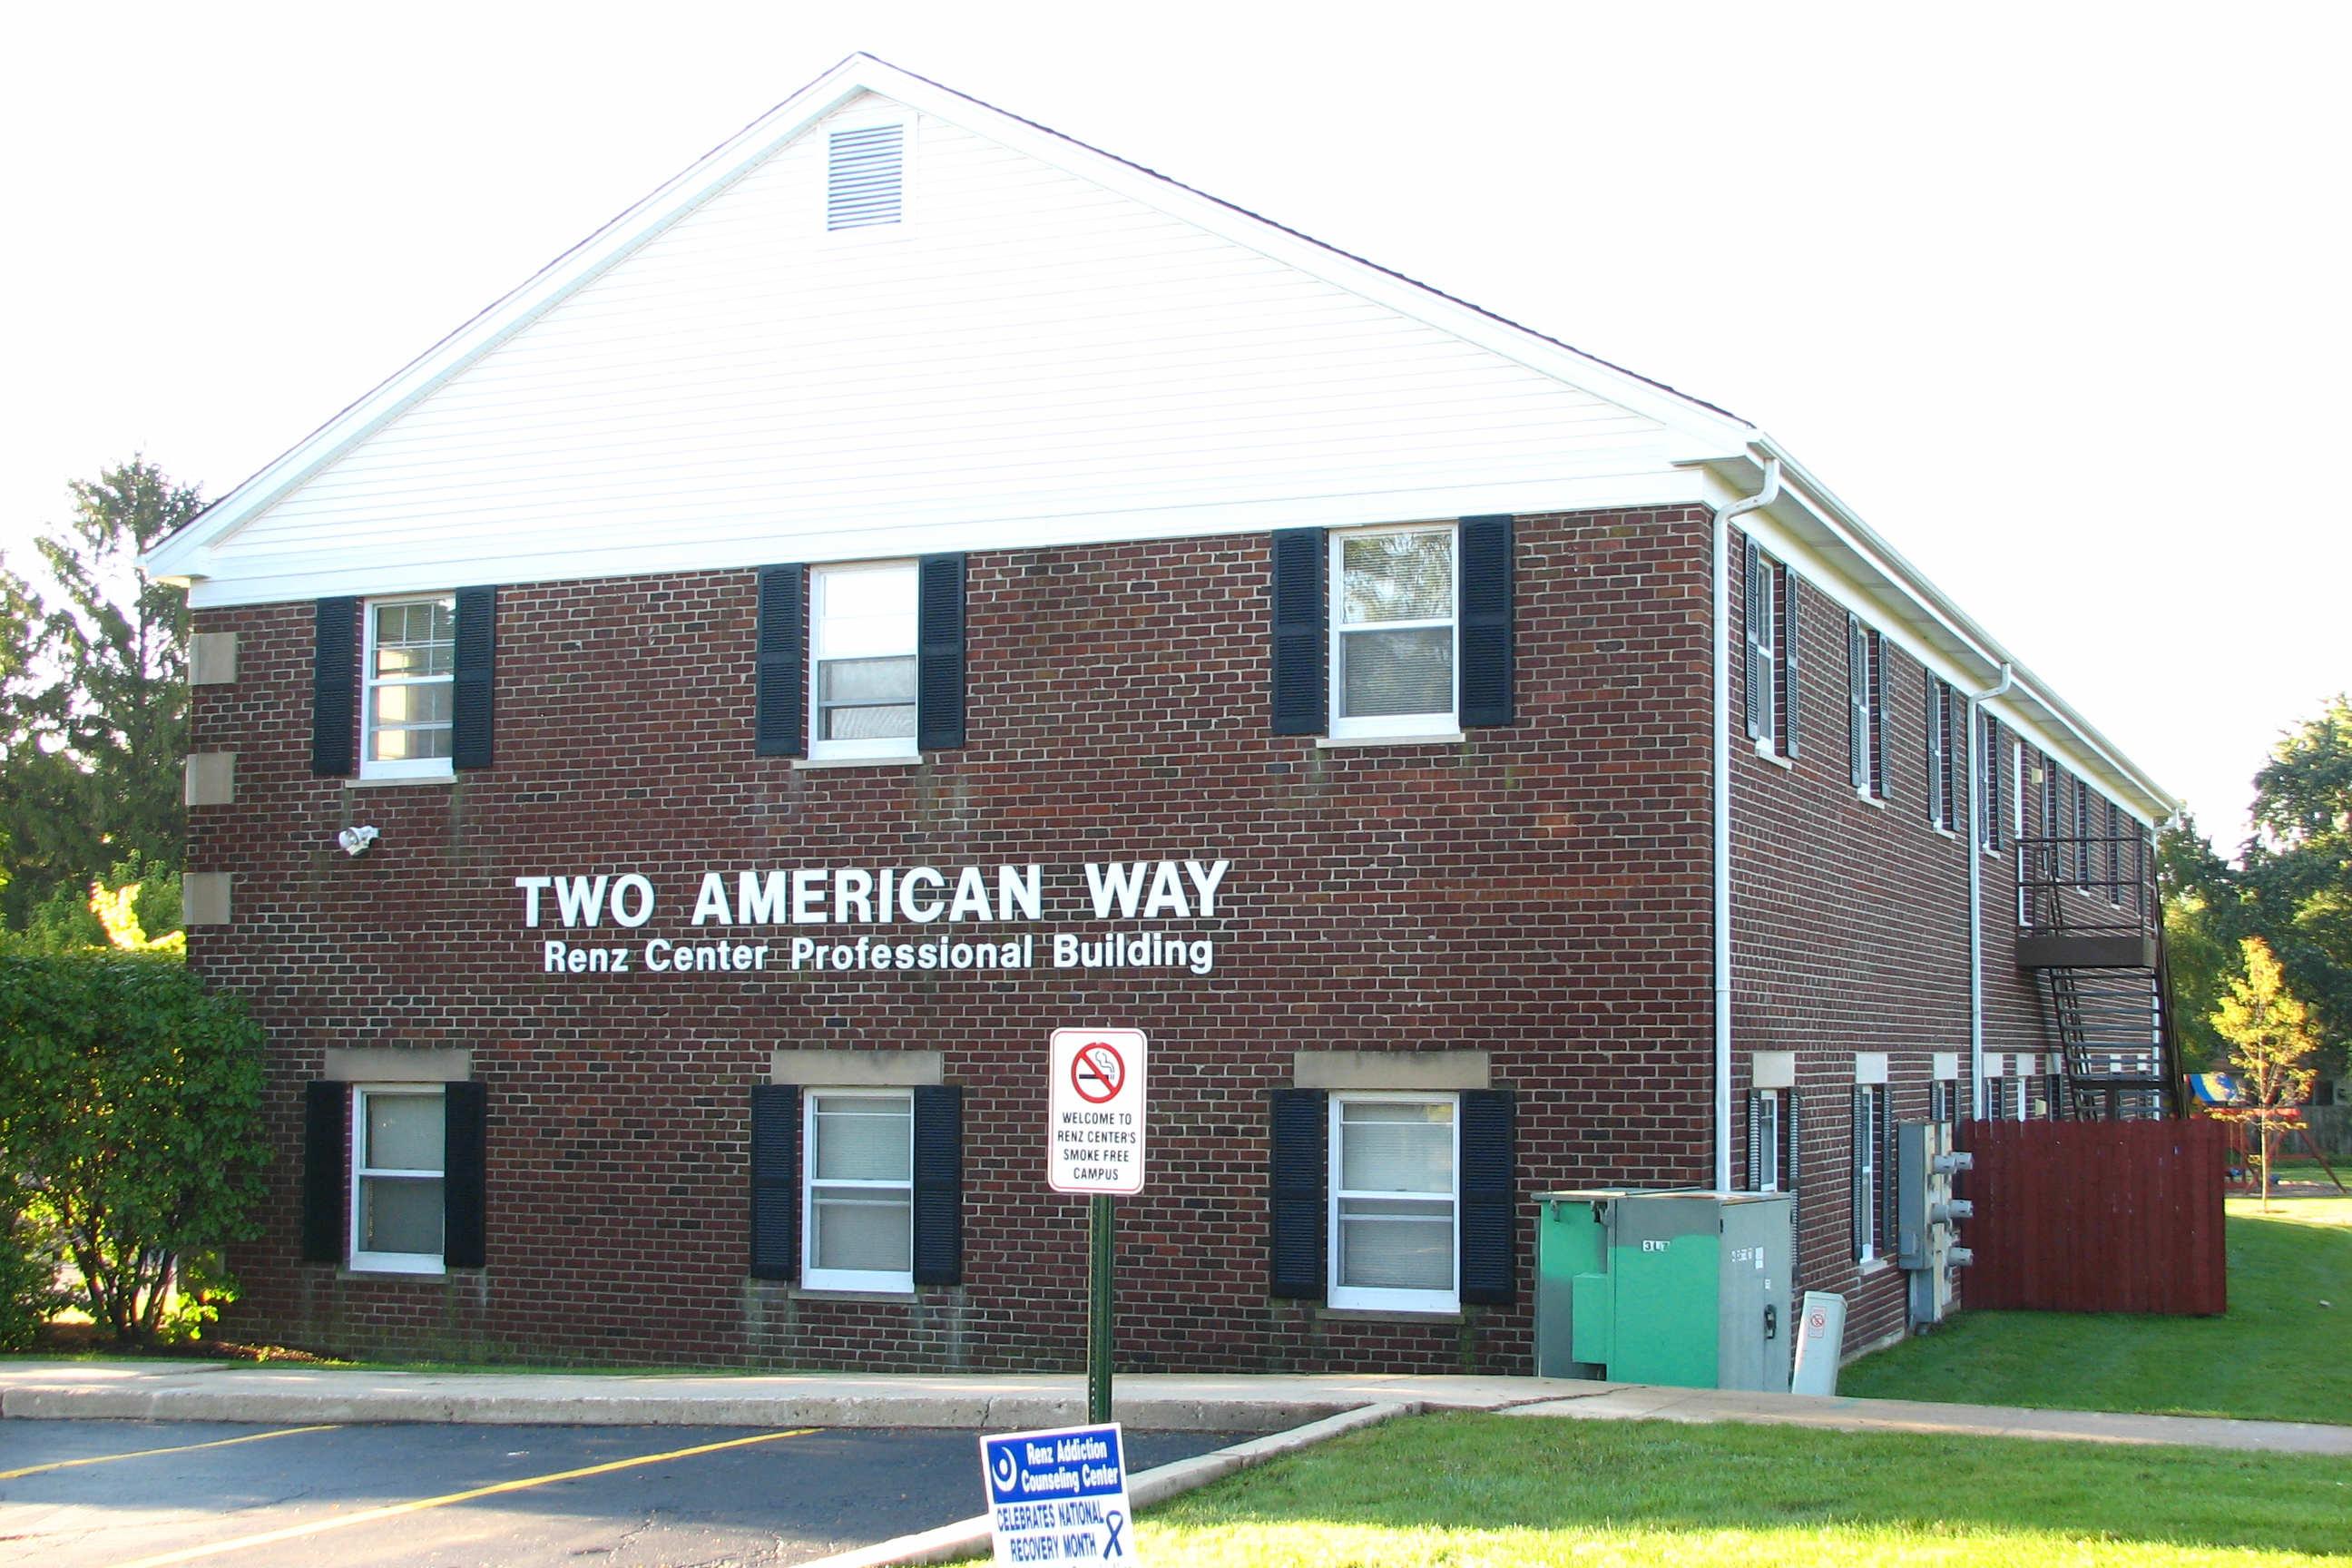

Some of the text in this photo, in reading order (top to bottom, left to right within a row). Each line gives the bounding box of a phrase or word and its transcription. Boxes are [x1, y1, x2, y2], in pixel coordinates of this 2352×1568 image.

[515, 860, 1230, 928] TWO AMERICAN WAY
[544, 932, 1213, 974] Renz Center Professional Building
[1063, 1112, 1132, 1124] WELCOME TO
[1058, 1131, 1136, 1143] RENZ CENTER'S
[1063, 1149, 1129, 1161] SMOKE FREE
[1073, 1167, 1118, 1181] CAMPUS
[1026, 1437, 1107, 1465] Renz Addiction
[1021, 1464, 1118, 1493] Counseling Center
[997, 1500, 1104, 1532] CELEBRATES NATIONAL
[1010, 1532, 1097, 1562] RECOVERY MONTH
